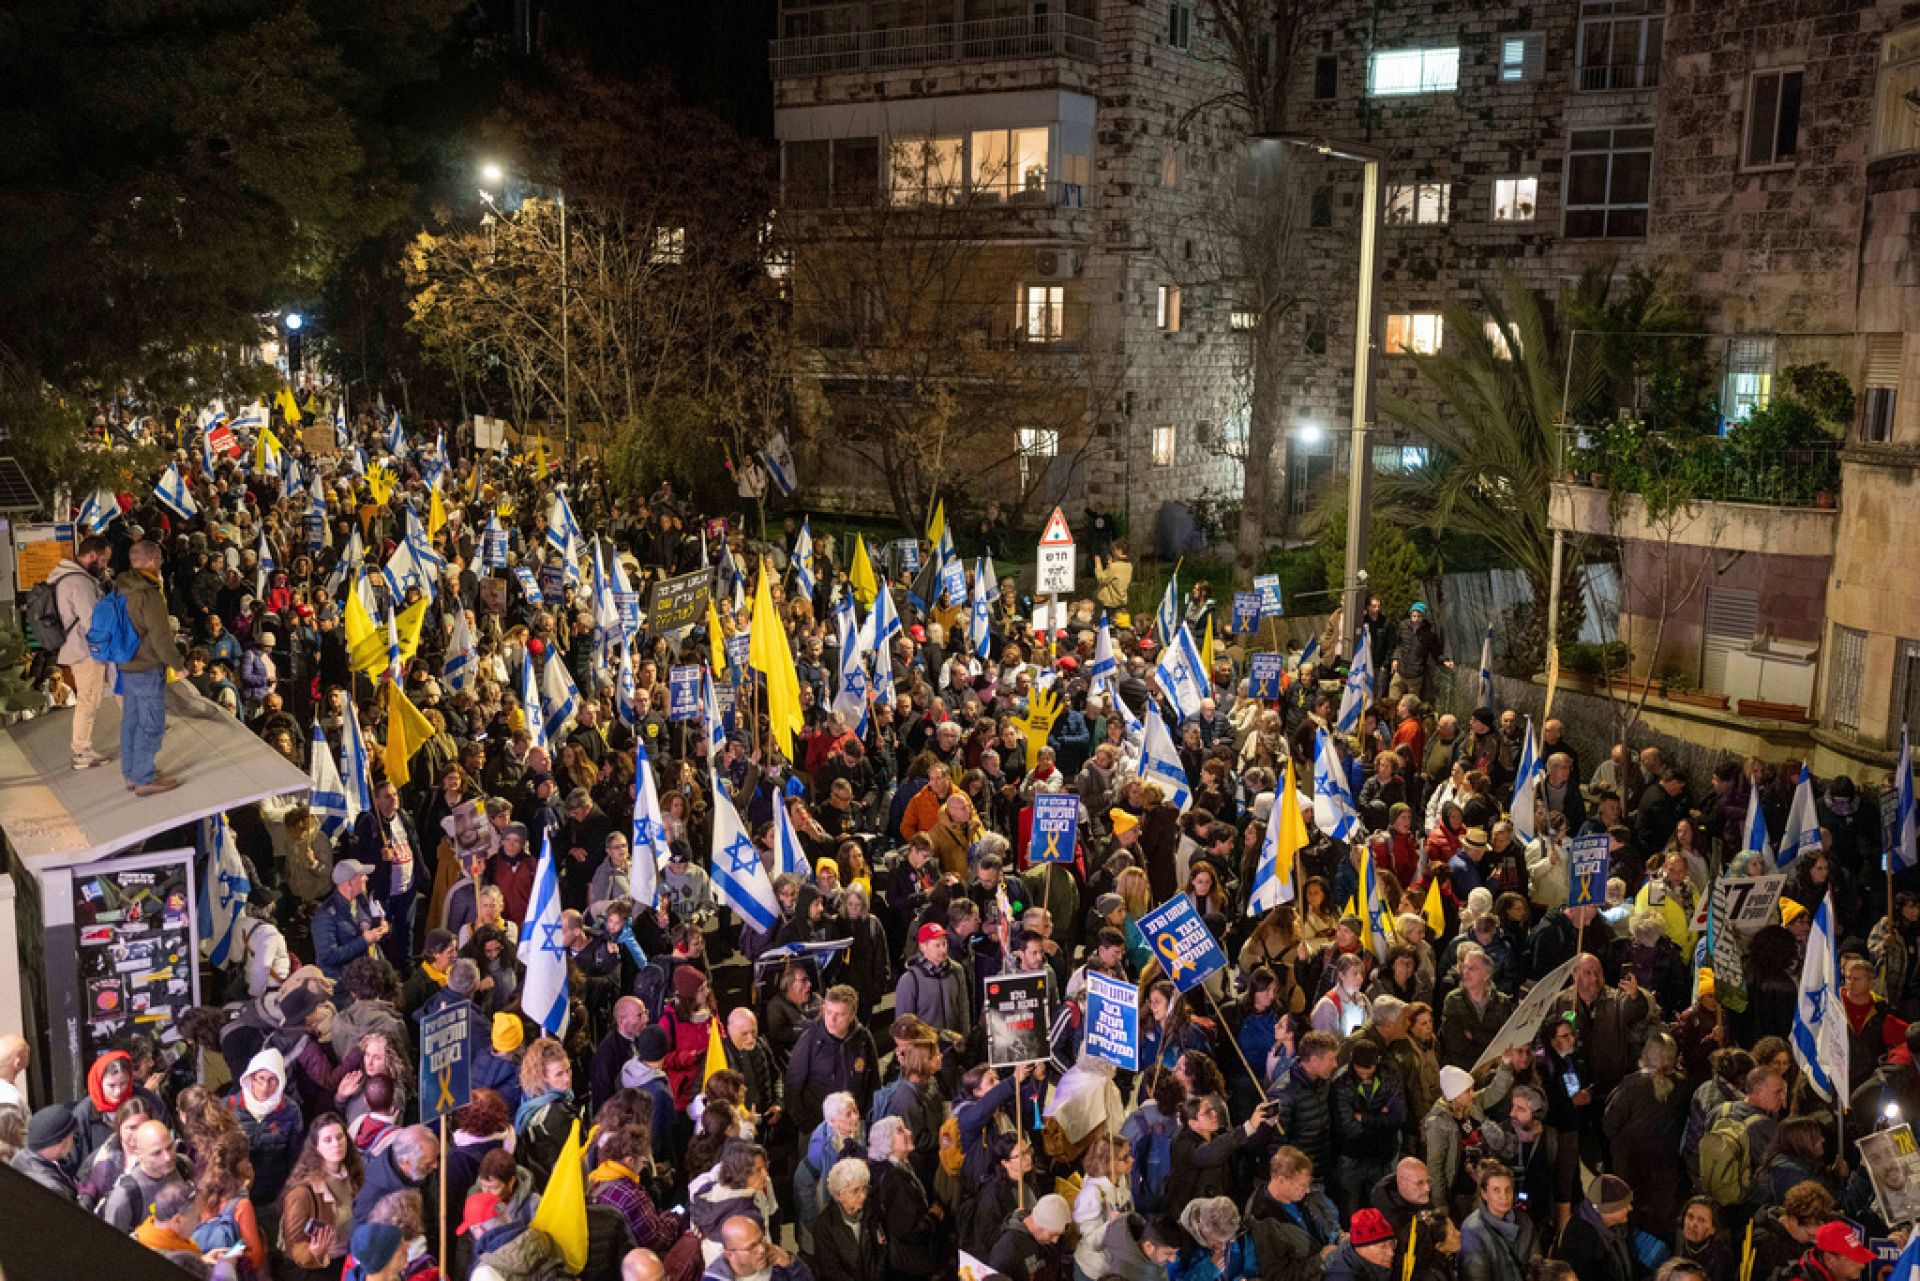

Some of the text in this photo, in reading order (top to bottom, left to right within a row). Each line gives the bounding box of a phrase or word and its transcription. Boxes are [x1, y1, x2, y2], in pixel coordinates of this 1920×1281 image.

[1046, 551, 1067, 561] חדש
[1175, 917, 1200, 937] בעד
[1102, 999, 1121, 1016] בעד
[1095, 1020, 1127, 1041] חקירה
[1088, 1032, 1134, 1058] ממלכתית
